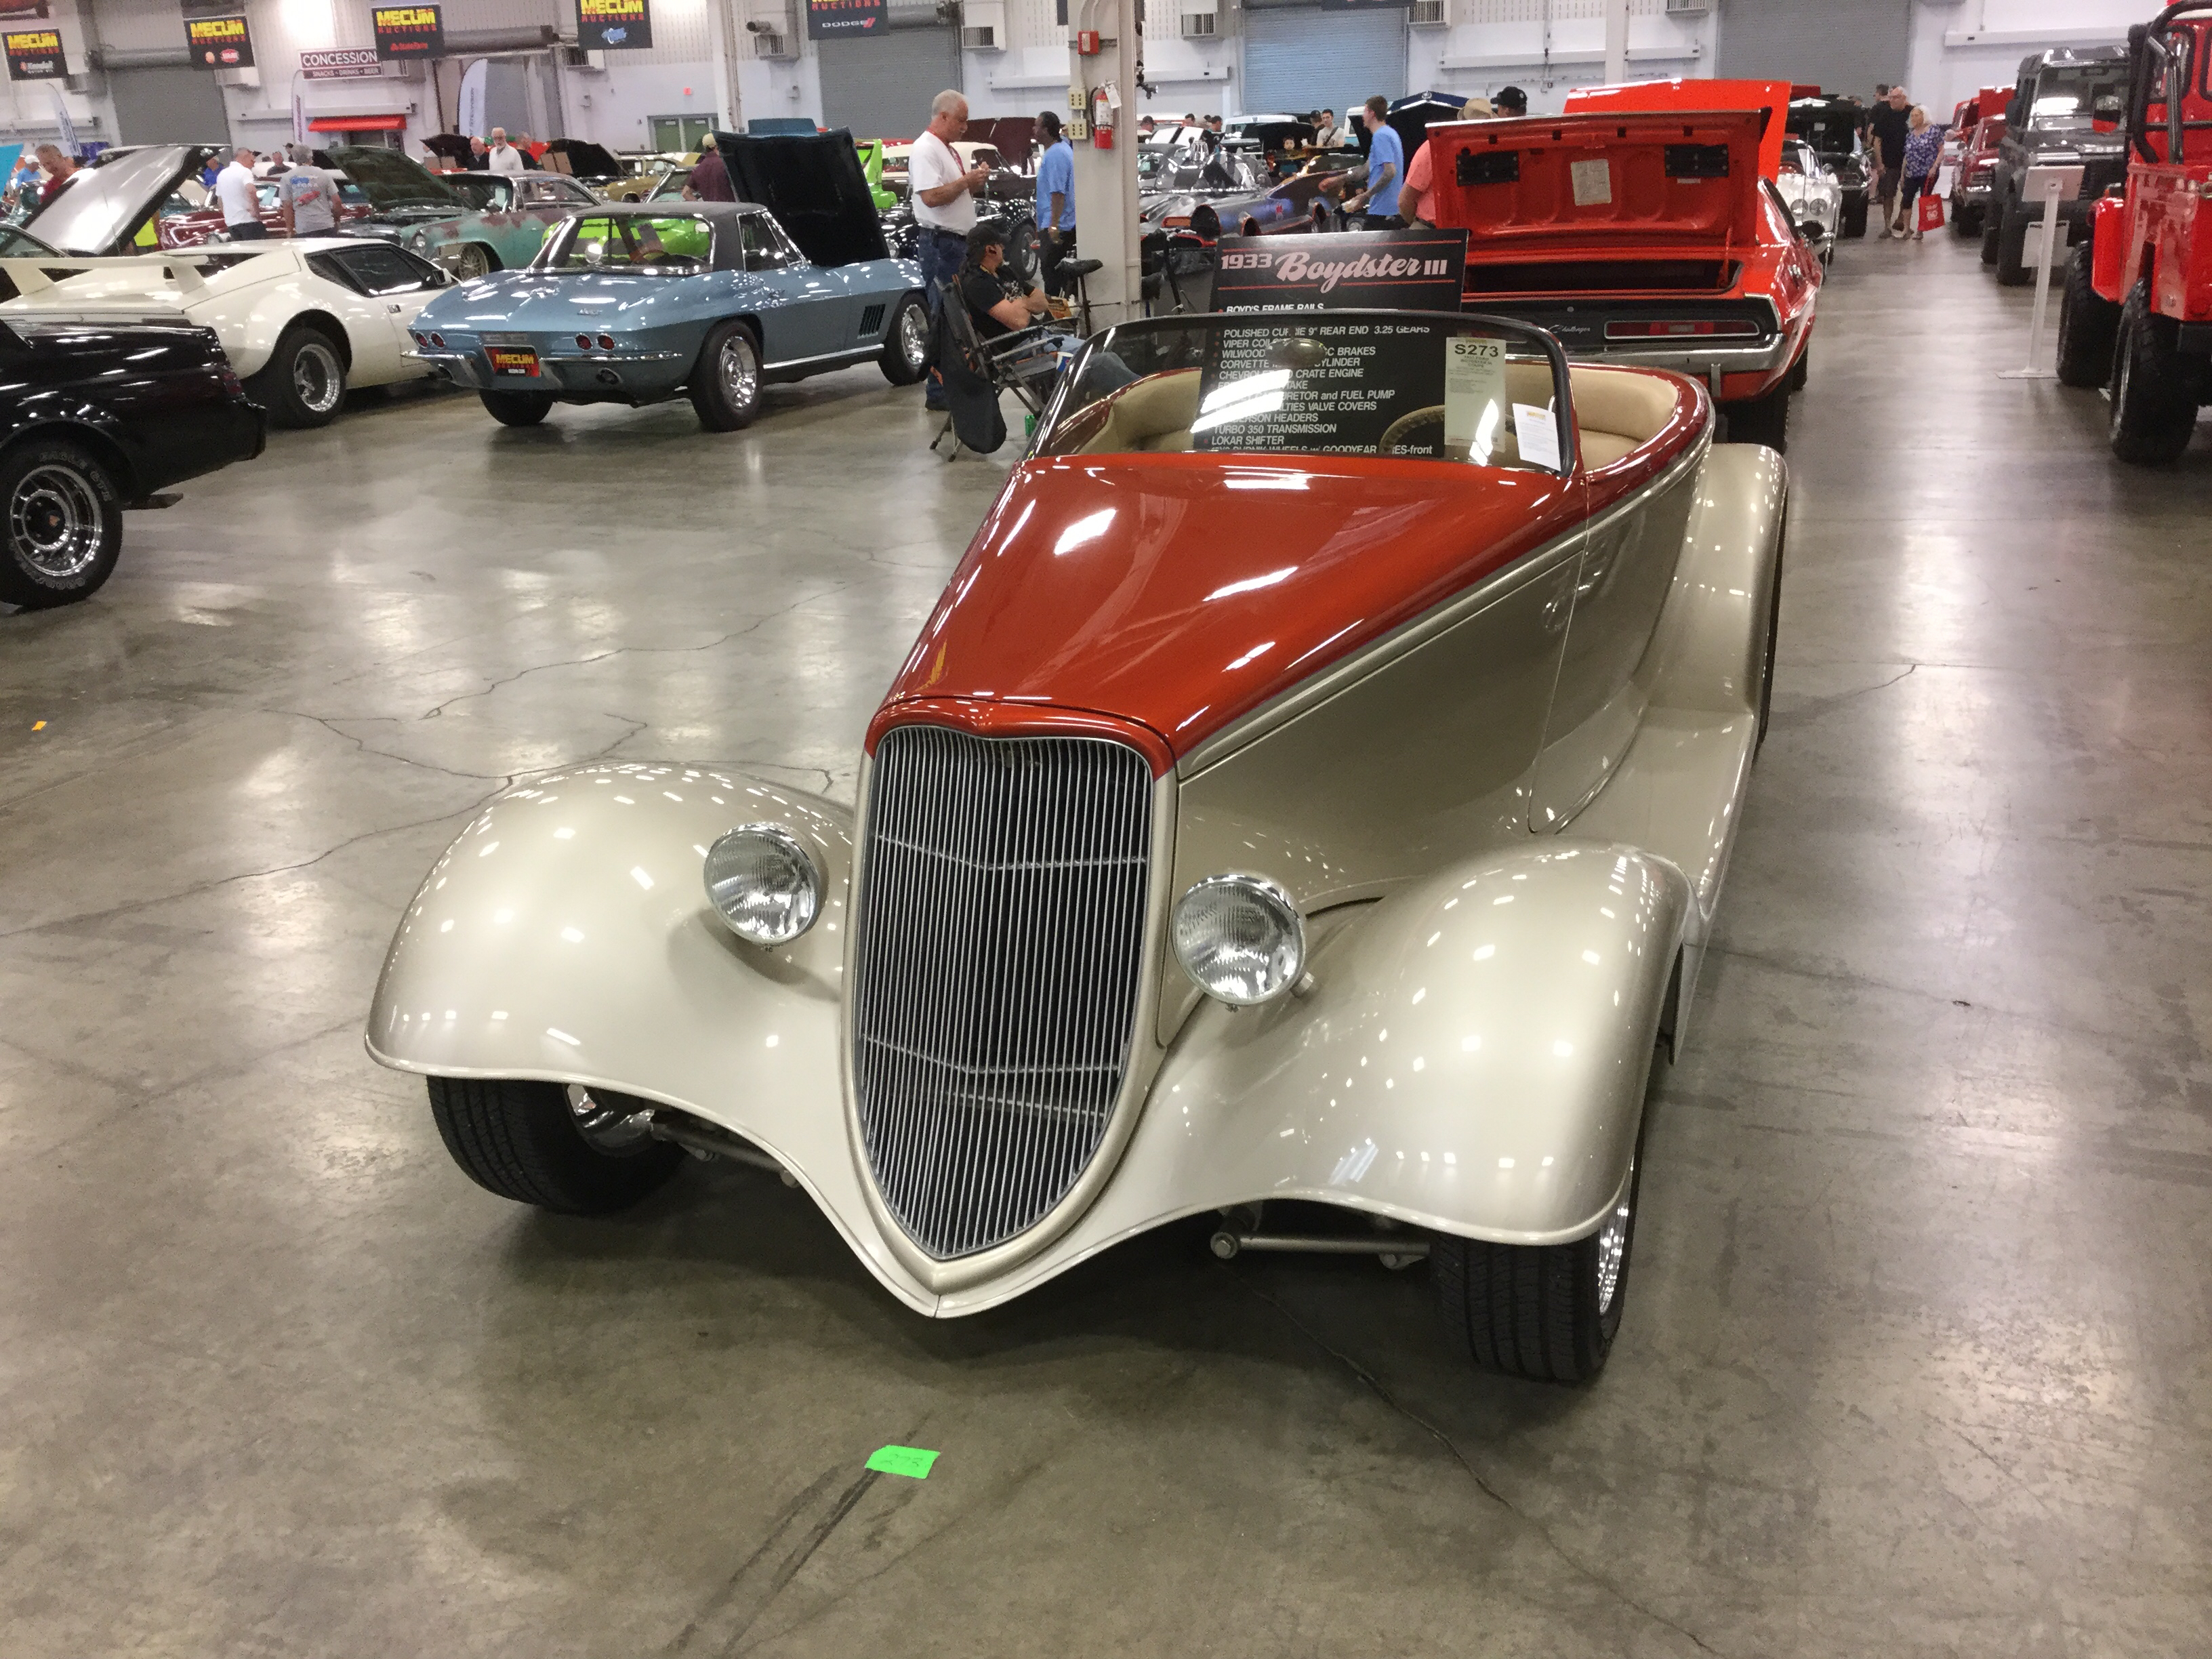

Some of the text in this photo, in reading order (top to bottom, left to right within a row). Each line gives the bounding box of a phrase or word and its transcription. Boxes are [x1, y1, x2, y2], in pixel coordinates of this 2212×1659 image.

[581, 0, 644, 15] MECUM
[811, 0, 880, 10] AUCTIONS
[376, 8, 436, 26] MECUM
[581, 14, 644, 22] AUCTIONS
[190, 19, 245, 38] MECUM
[7, 32, 59, 49] MECUM
[302, 50, 378, 66] CONCESSION
[1221, 251, 1448, 293] 1933 Boydster III
[1223, 328, 1269, 338] POLISHED
[1319, 326, 1346, 335] REAR
[1349, 325, 1369, 335] END
[1374, 325, 1393, 334] 3.25
[1223, 339, 1250, 348] VIPER
[1222, 348, 1266, 359] WILWOOD
[1336, 346, 1376, 356] BRAKES
[1454, 344, 1498, 357] S273
[495, 354, 534, 364] MECUM
[1220, 359, 1269, 369] CORVETTE
[1295, 368, 1326, 378] CRATE
[1328, 368, 1364, 377] ENGINE
[1321, 391, 1338, 401] and
[1340, 390, 1365, 400] FUEL
[1367, 390, 1395, 399] PUMP
[1308, 402, 1336, 411] VALVE
[1338, 401, 1377, 411] COVERS
[1273, 412, 1319, 423] HEADERS
[1214, 423, 1337, 434] TURBO 350 TRANSMISSION
[1211, 435, 1285, 446] LOKAR SHIFTER
